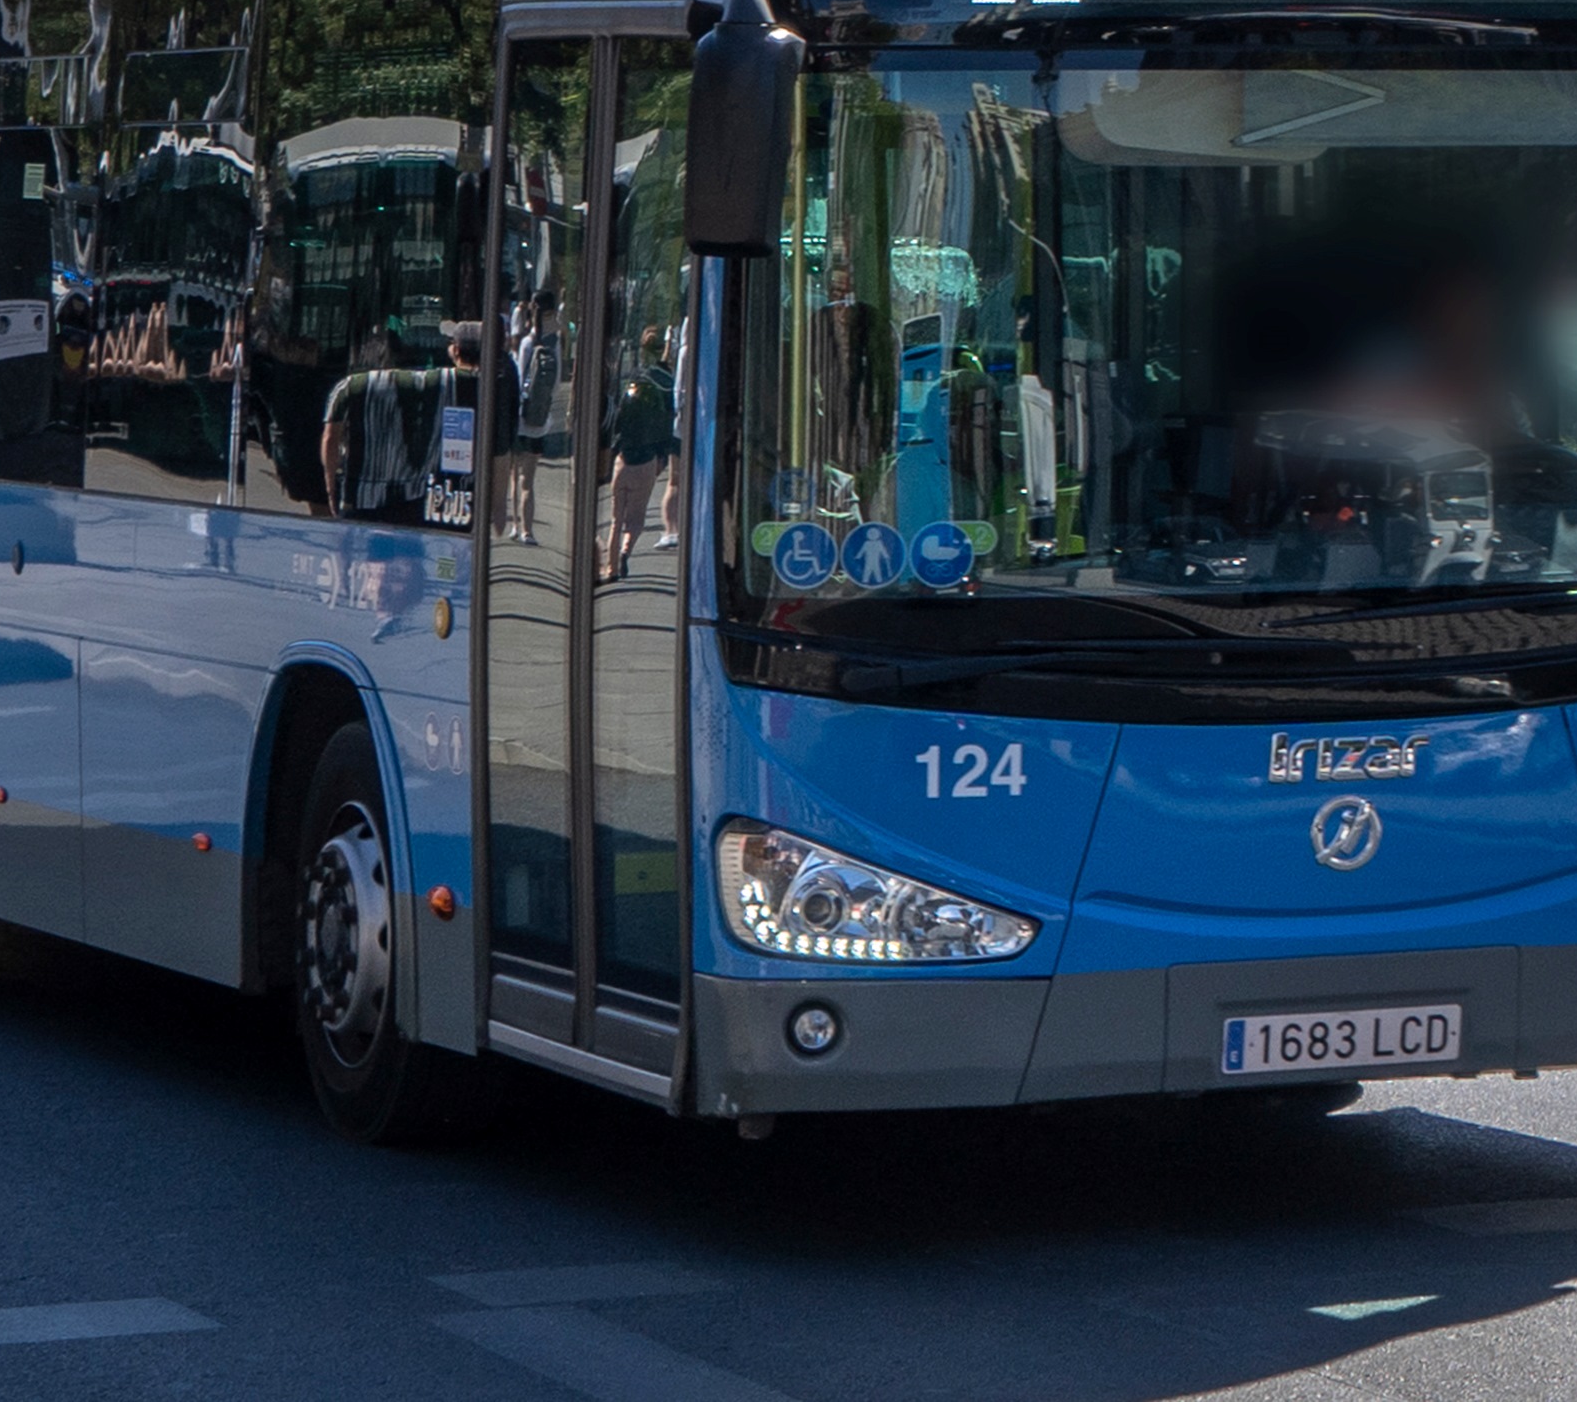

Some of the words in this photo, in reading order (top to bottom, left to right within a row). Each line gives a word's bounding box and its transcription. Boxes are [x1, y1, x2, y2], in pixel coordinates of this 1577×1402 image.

[915, 743, 1027, 798] 124
[1268, 731, 1430, 783] Irizar
[1259, 1019, 1357, 1064] 1683
[1372, 1014, 1449, 1057] LCD
